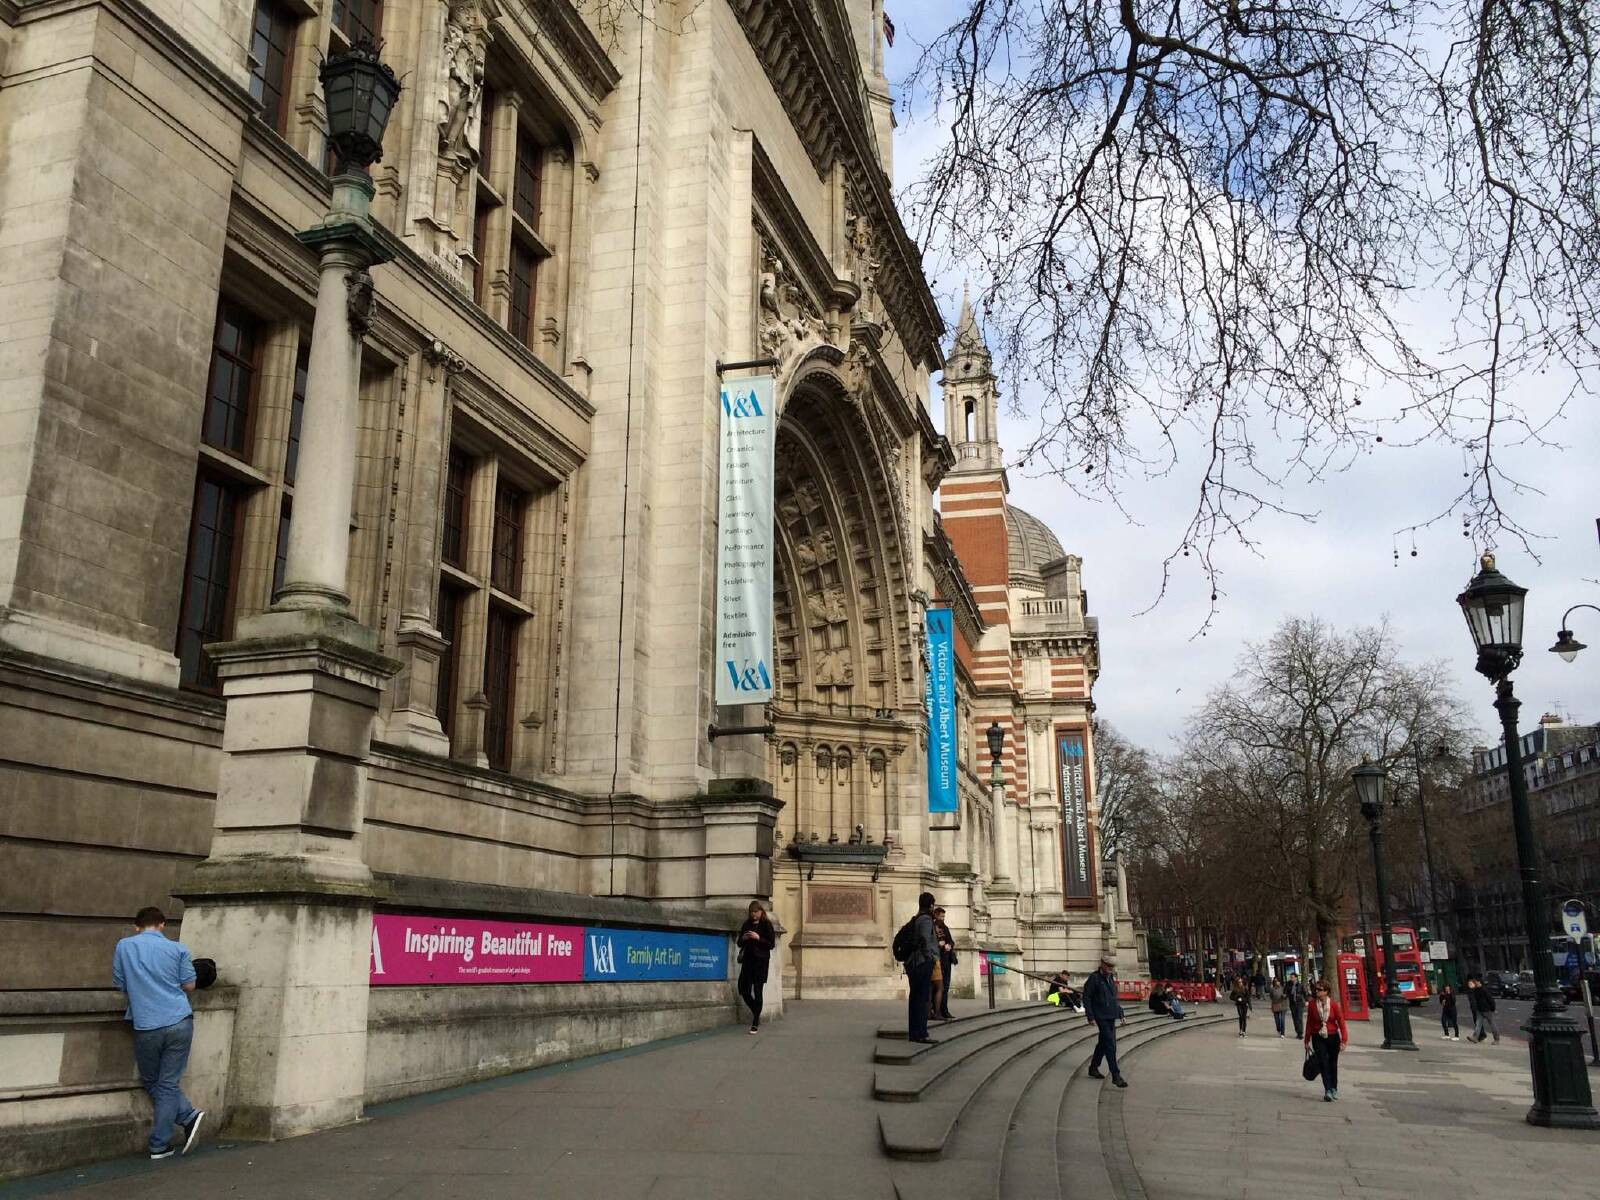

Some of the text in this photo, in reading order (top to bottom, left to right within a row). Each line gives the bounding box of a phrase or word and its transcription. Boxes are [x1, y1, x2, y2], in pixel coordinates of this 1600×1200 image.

[720, 389, 766, 418] V&A
[722, 630, 757, 639] Admission
[722, 641, 737, 649] free
[725, 658, 772, 692] V&A
[938, 641, 950, 790] Victoria and Albert Museum
[1062, 763, 1074, 825] Admission free
[1074, 763, 1088, 882] Victoria and Albert Museum
[404, 926, 572, 963] Inspiring Beautiful Free
[590, 934, 616, 974] V&A
[626, 946, 682, 970] Family Art Fun
